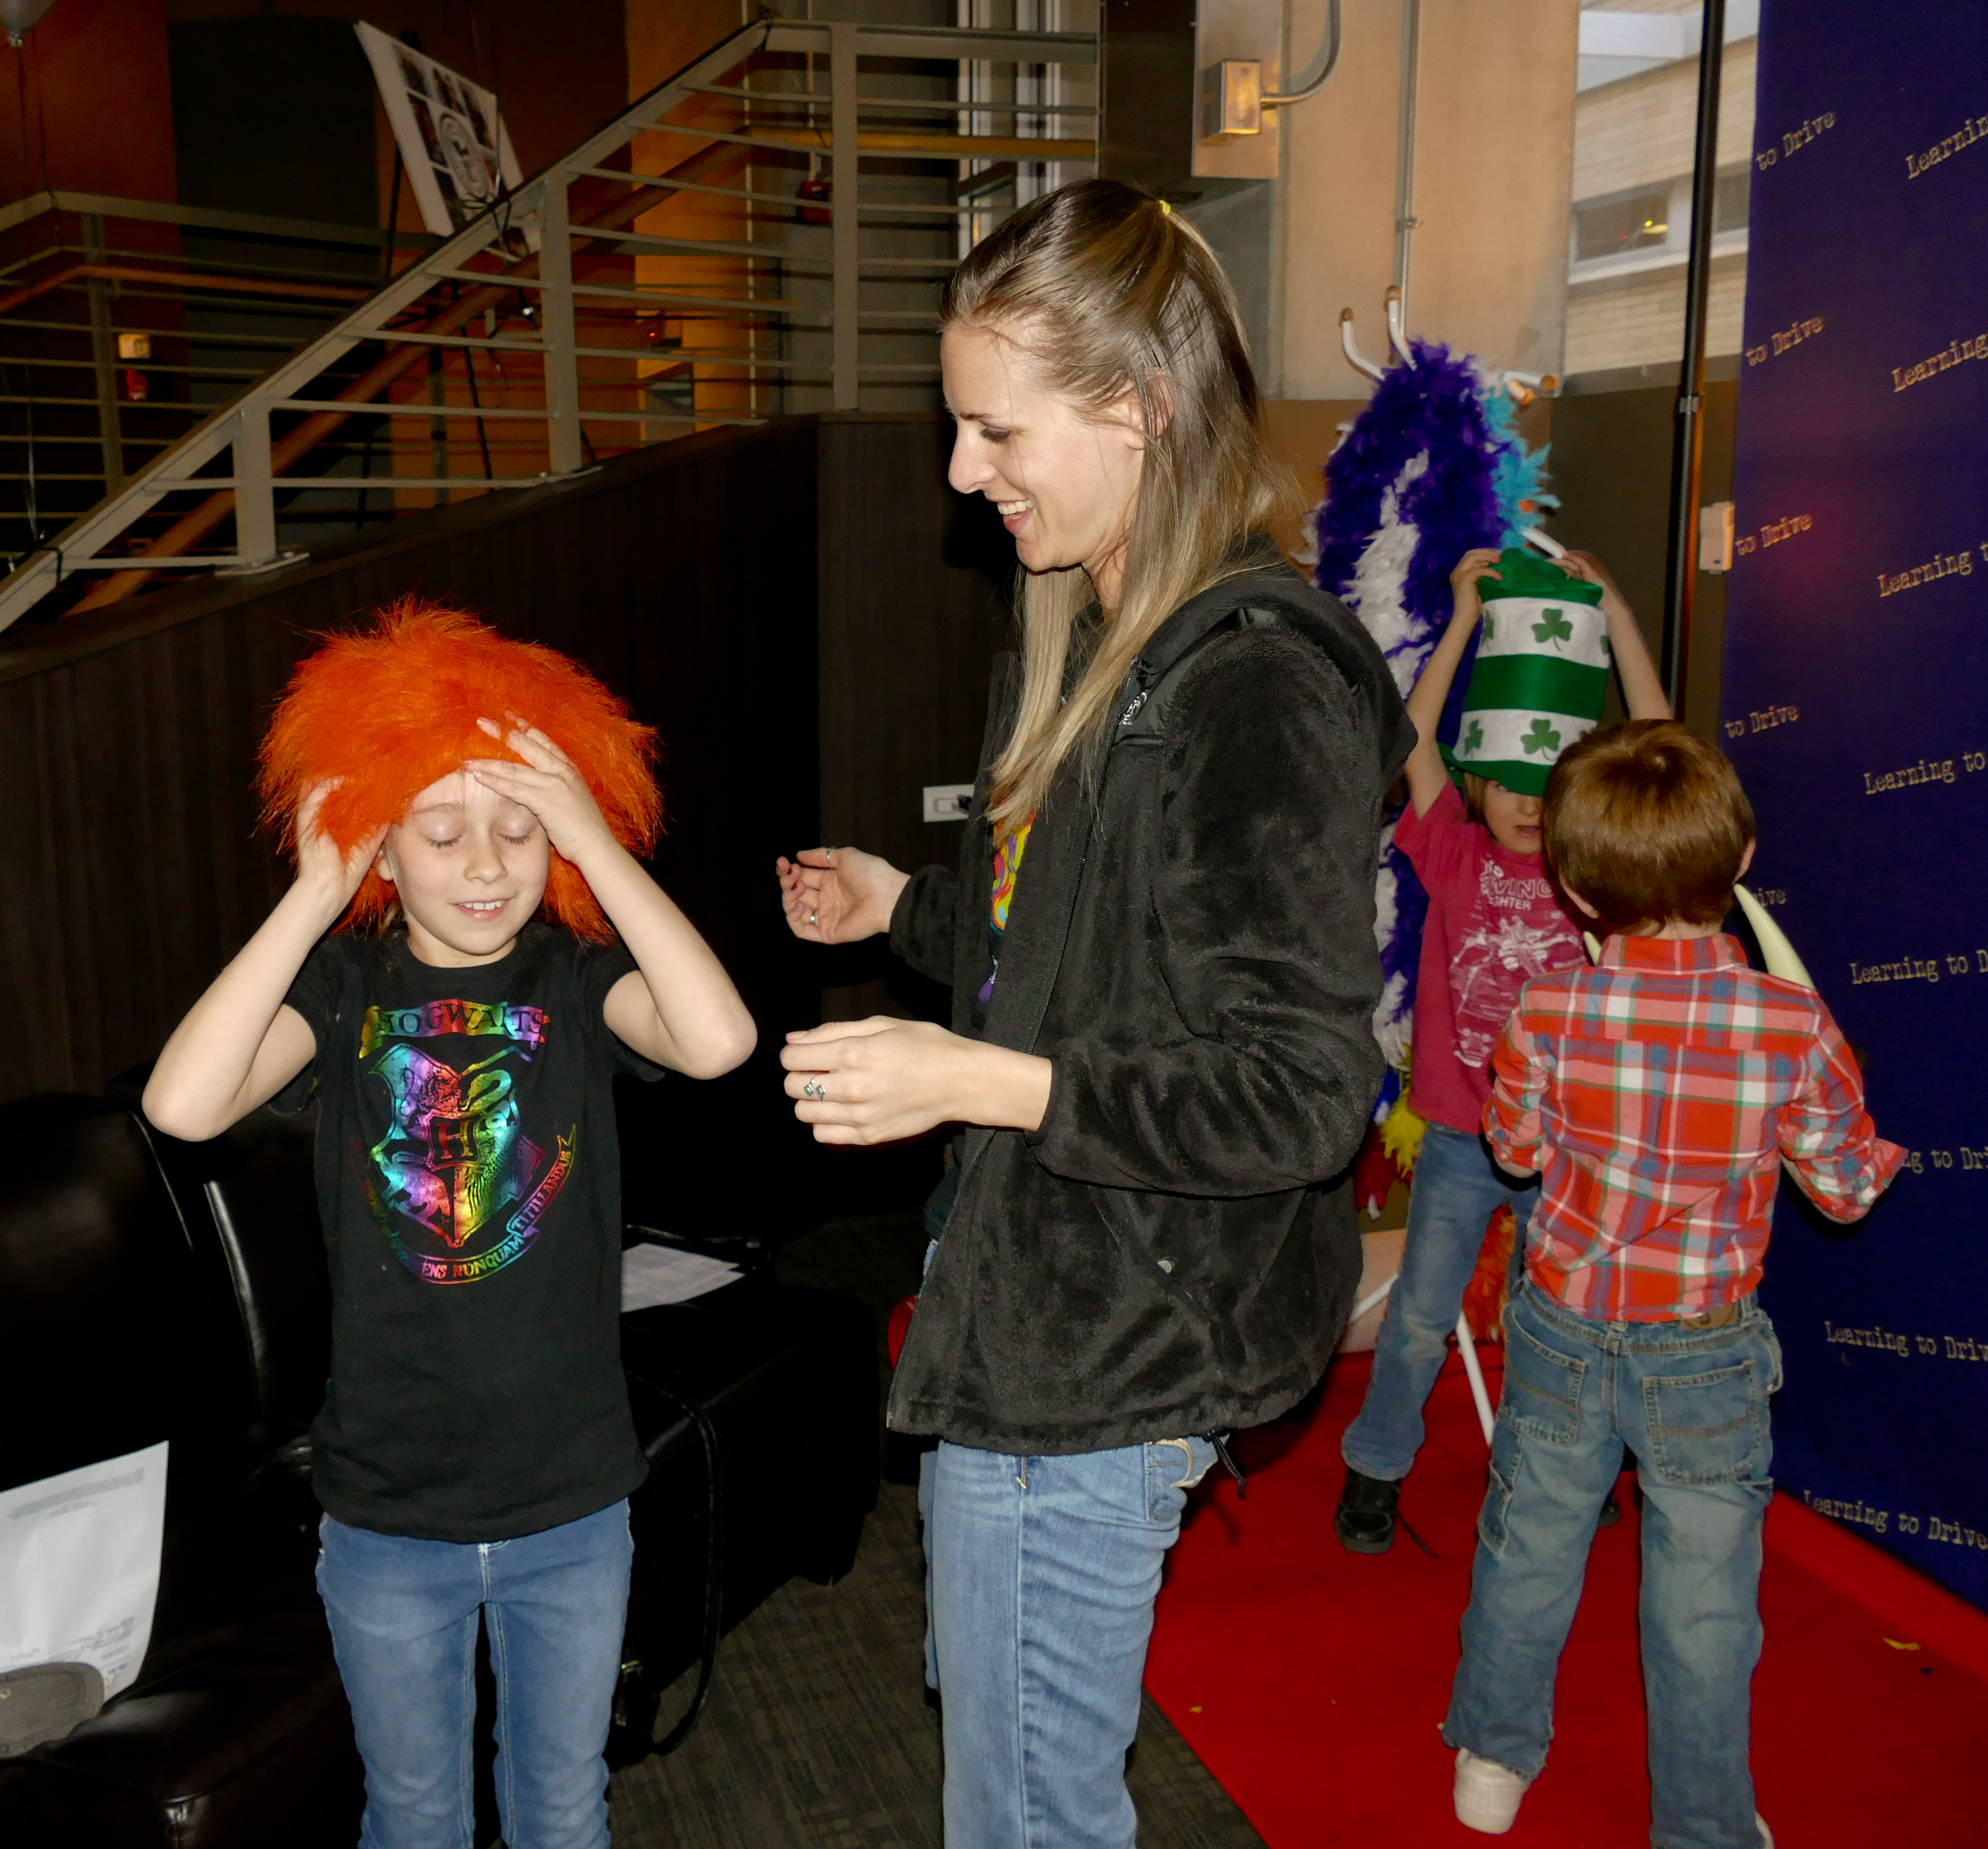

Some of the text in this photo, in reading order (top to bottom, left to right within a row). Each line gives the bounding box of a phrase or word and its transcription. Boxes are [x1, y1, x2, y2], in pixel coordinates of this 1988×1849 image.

[1756, 110, 1836, 170] to Drive
[1905, 115, 1988, 179] Learnin
[1746, 316, 1825, 366] to Drive
[1891, 332, 1988, 393] Learning
[1735, 513, 1813, 556] to Drive
[1877, 550, 1973, 598] Learning
[1725, 706, 1800, 738] to Drive
[1863, 751, 1985, 795] Learning to
[1850, 956, 1939, 984] Learning
[1946, 953, 1969, 975] to
[1930, 1149, 1953, 1168] to
[453, 1235, 524, 1278] NUNQUAM
[510, 1151, 572, 1230] TITILLANDUS
[1824, 1320, 1988, 1362] Learning to Driv
[1803, 1490, 1988, 1550] Learning to Drive
